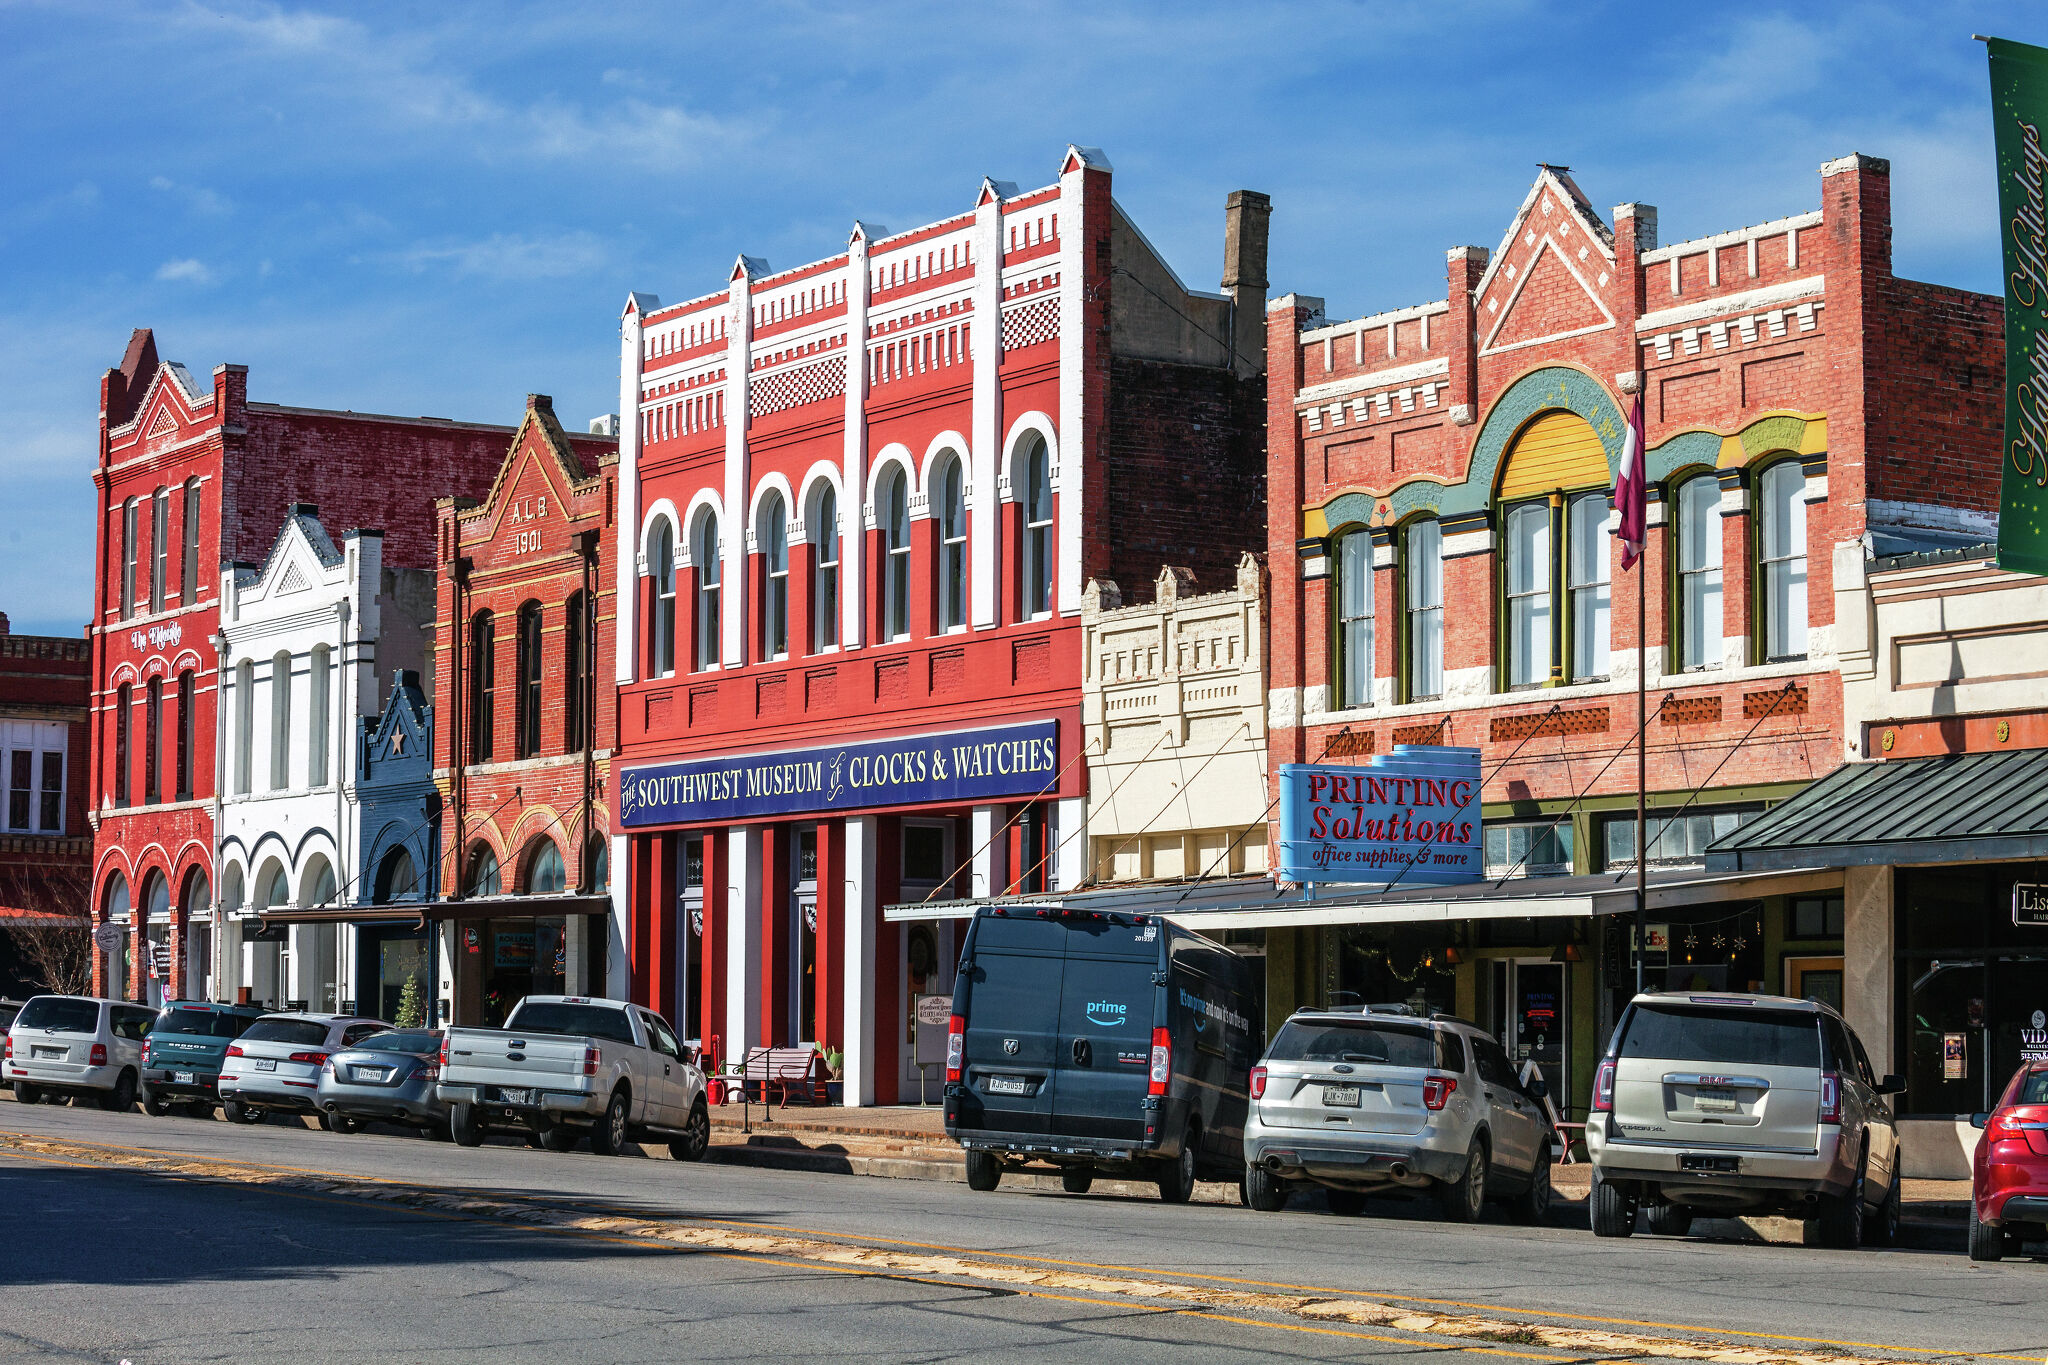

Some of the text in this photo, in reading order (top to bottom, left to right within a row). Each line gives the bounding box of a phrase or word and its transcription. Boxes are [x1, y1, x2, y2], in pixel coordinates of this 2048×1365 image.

[515, 529, 543, 555] 1901
[131, 631, 147, 653] The
[149, 660, 162, 673] food
[179, 656, 196, 669] events
[118, 667, 134, 682] coffee
[621, 782, 636, 808] THE
[638, 769, 742, 808] SOUTHWEST
[746, 761, 822, 798] MUSEUM
[849, 749, 926, 788] CLOCKS
[932, 749, 949, 781] &
[952, 737, 1055, 779] WATCHES
[1308, 774, 1473, 808] PRINTING
[1310, 805, 1473, 844] Solutions
[1312, 845, 1468, 868] office supplies & more
[1086, 1000, 1127, 1014] prime
[2021, 1029, 2048, 1043] VID
[1699, 1075, 1734, 1085] GMC
